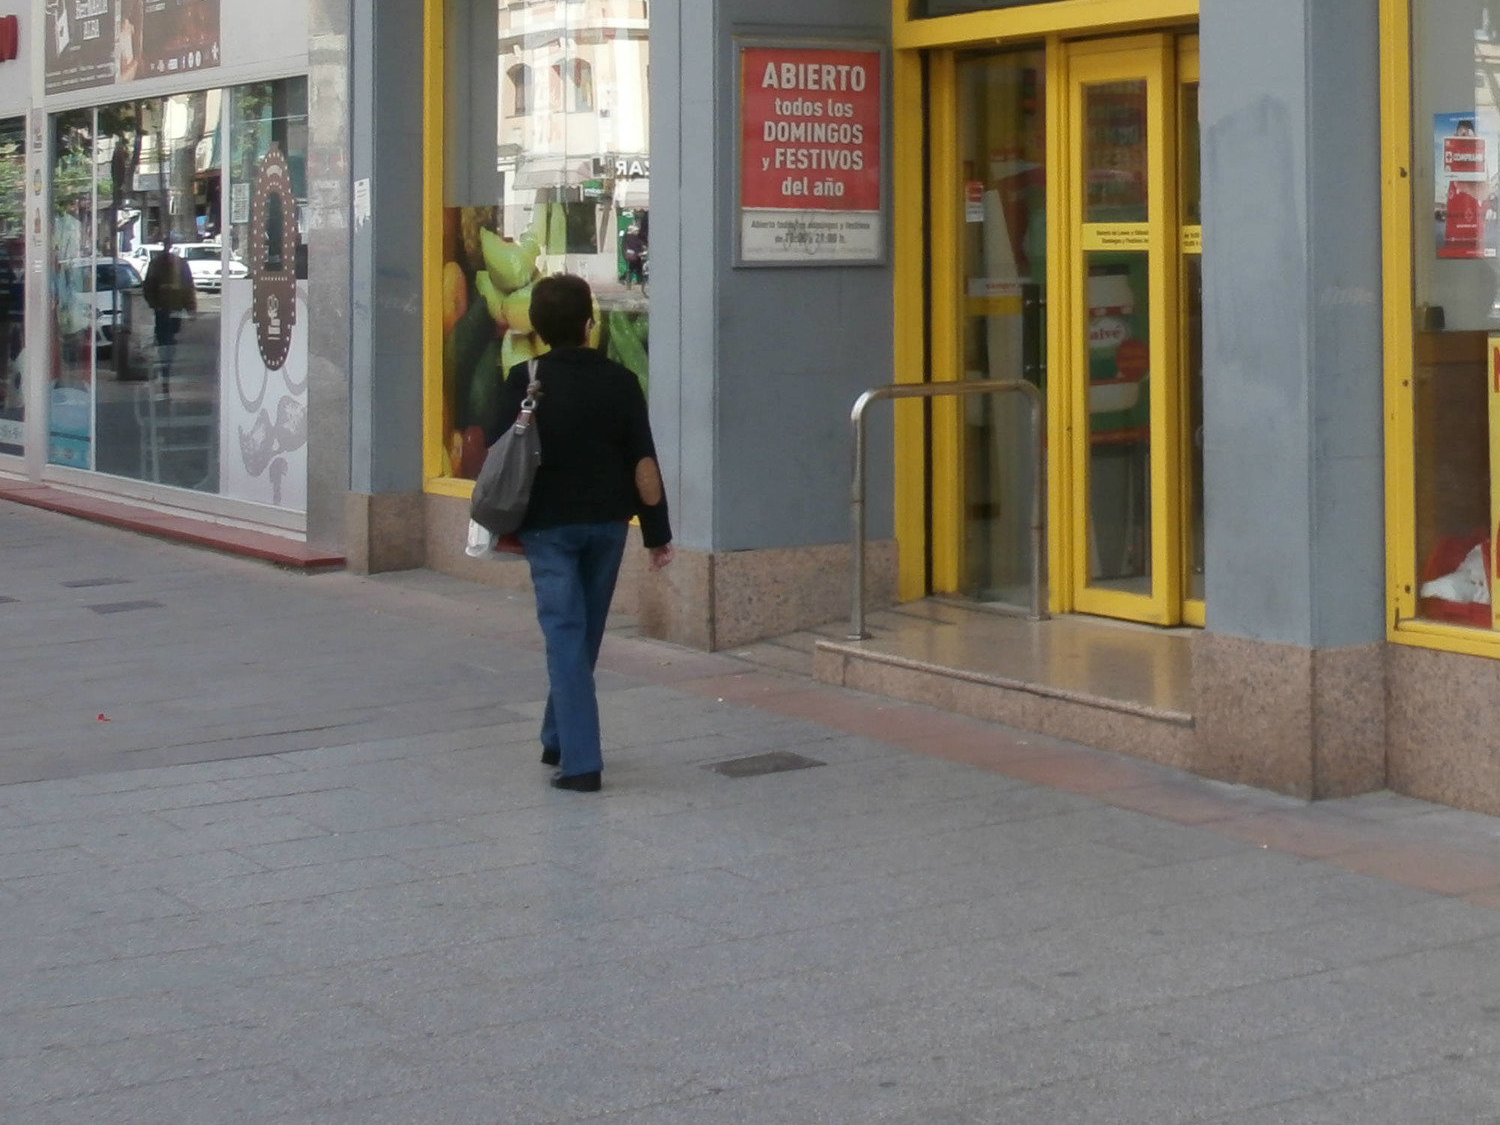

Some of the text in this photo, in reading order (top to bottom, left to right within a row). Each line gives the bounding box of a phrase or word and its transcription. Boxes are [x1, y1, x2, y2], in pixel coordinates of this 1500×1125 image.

[762, 61, 866, 92] ABIERTO
[775, 97, 854, 118] todos los
[763, 121, 864, 145] DOMINGOS
[762, 148, 864, 171] y FESTIVOS
[781, 176, 845, 197] del año
